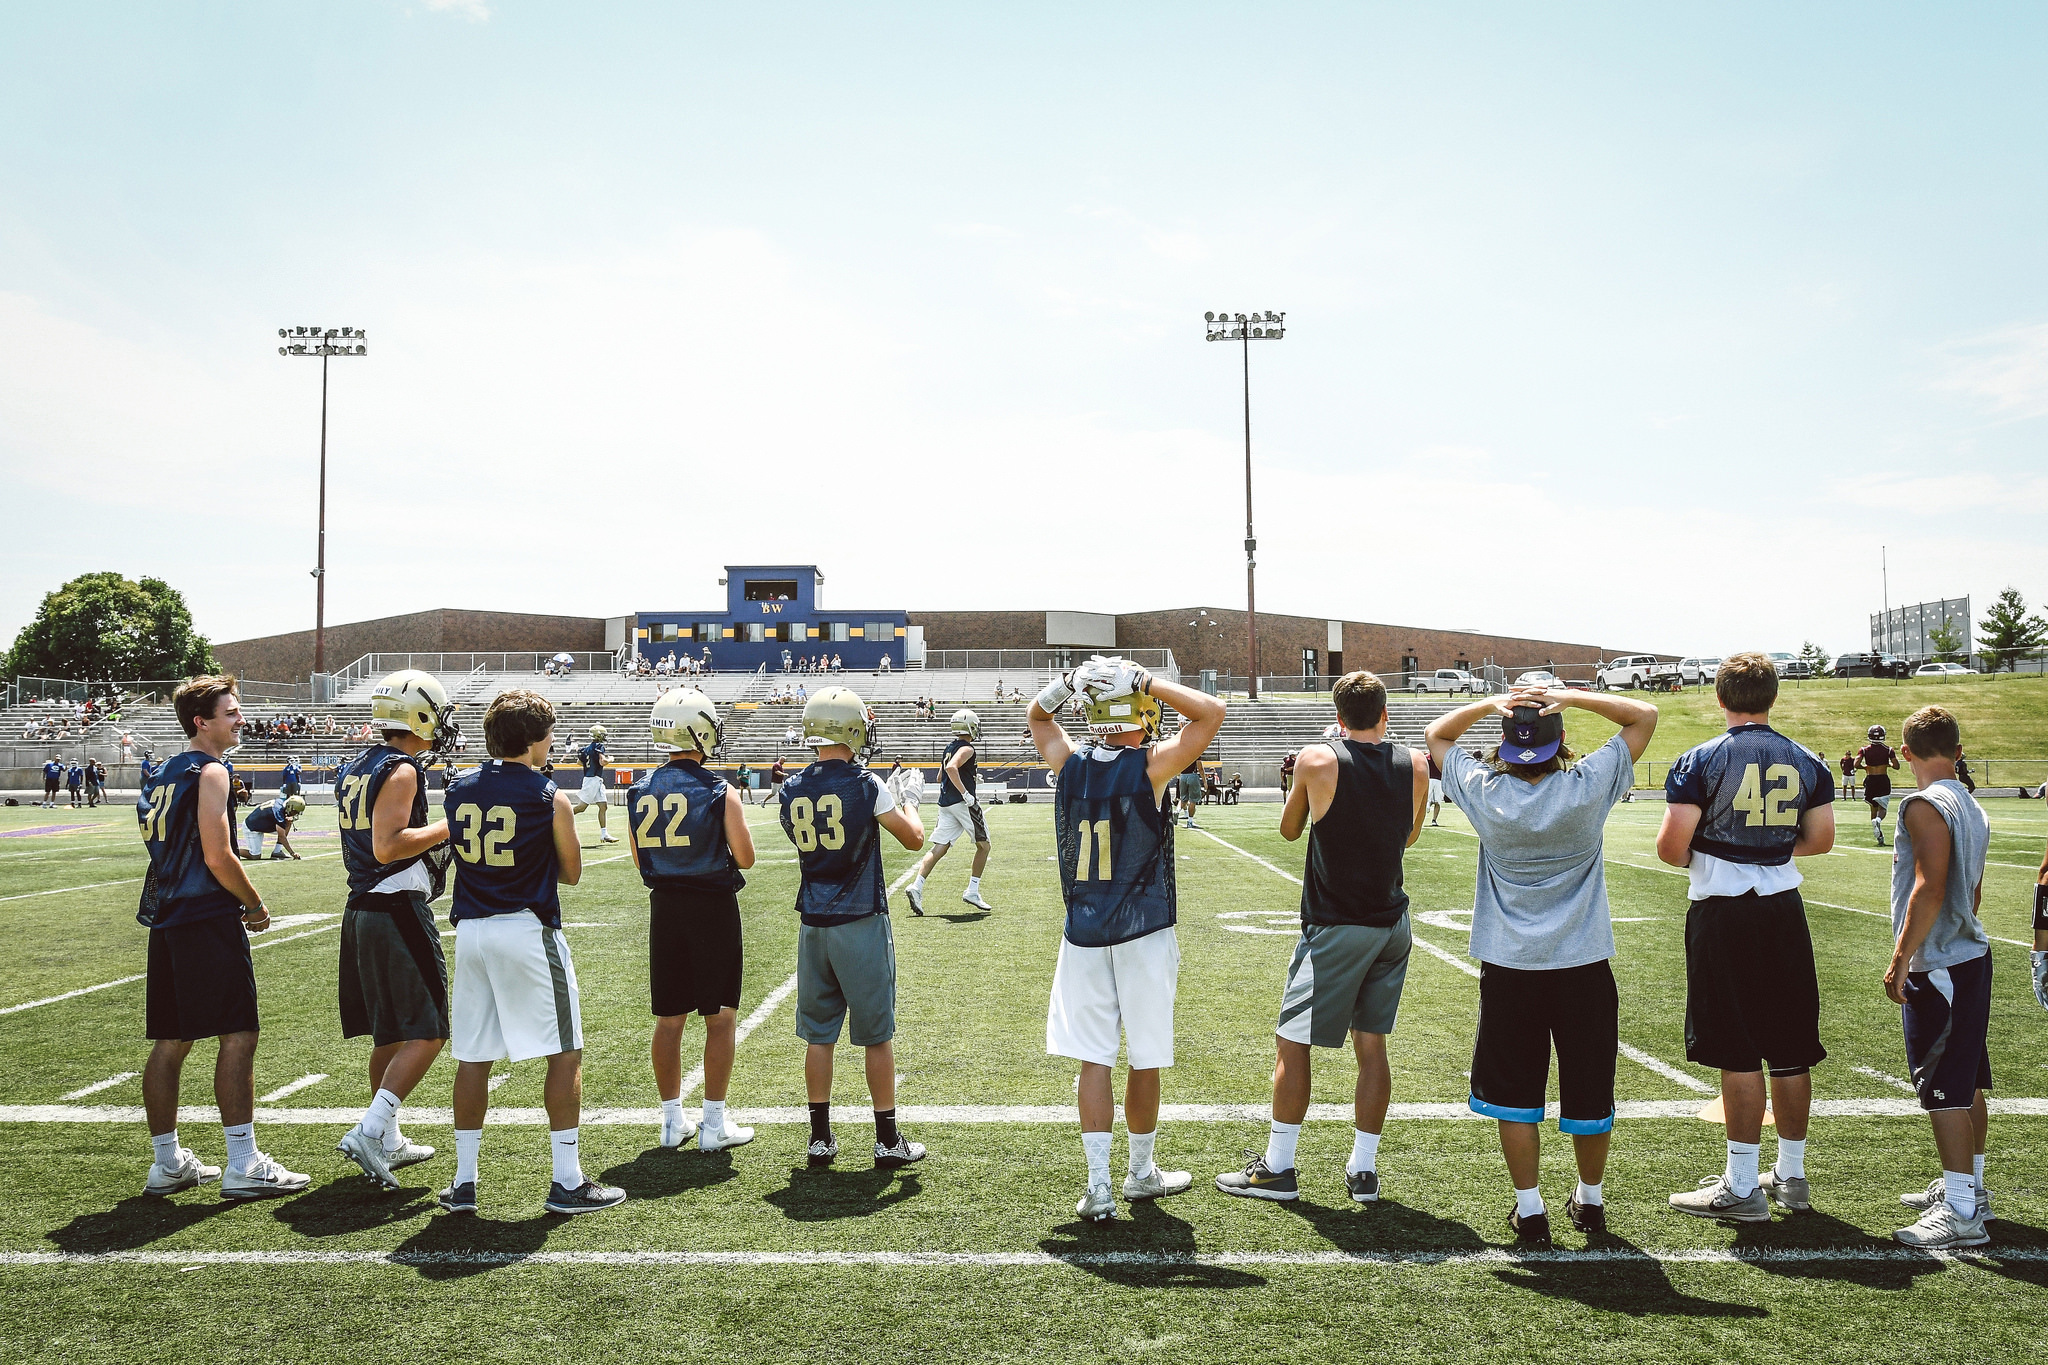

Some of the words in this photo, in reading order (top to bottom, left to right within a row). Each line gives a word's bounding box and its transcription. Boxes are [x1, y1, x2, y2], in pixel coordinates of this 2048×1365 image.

[652, 718, 674, 728] AMILY
[1089, 724, 1123, 734] Riddell
[140, 783, 176, 842] 31
[636, 792, 691, 849] 22
[790, 793, 846, 853] 83
[1732, 763, 1800, 827] 42
[454, 802, 517, 867] 32
[1076, 819, 1112, 882] 11
